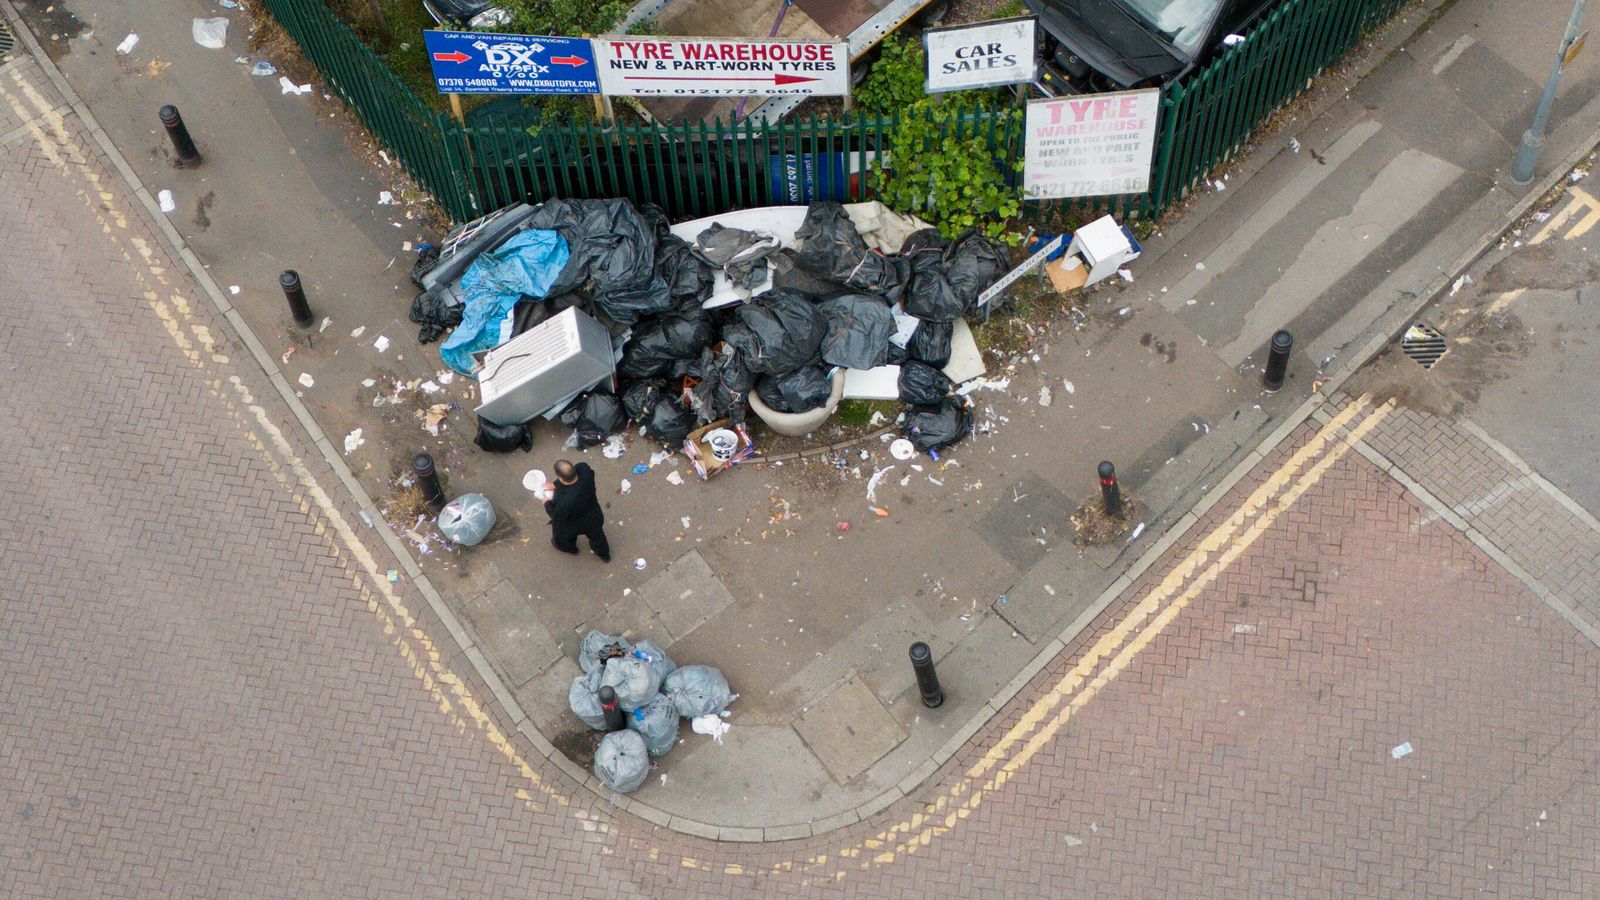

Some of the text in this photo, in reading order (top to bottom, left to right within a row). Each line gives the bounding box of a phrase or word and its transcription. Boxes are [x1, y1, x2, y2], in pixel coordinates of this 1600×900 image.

[485, 49, 538, 66] DX
[609, 42, 834, 61] TYRE WAREHOUSE
[955, 42, 1003, 59] CAR
[478, 64, 550, 74] AUTOFIX
[609, 60, 836, 71] NEW & PART-WORN TYRES
[942, 54, 1017, 75] SALES
[508, 79, 597, 88] WWW.DXAUTOFIX.COM
[1045, 96, 1138, 125] TYRE
[1036, 119, 1147, 138] WAREHOUSE
[1039, 138, 1066, 147] OPEN
[1068, 137, 1080, 145] TO
[1103, 132, 1140, 141] PUBLIC
[1038, 147, 1071, 158] NEW
[1106, 142, 1143, 153] PART
